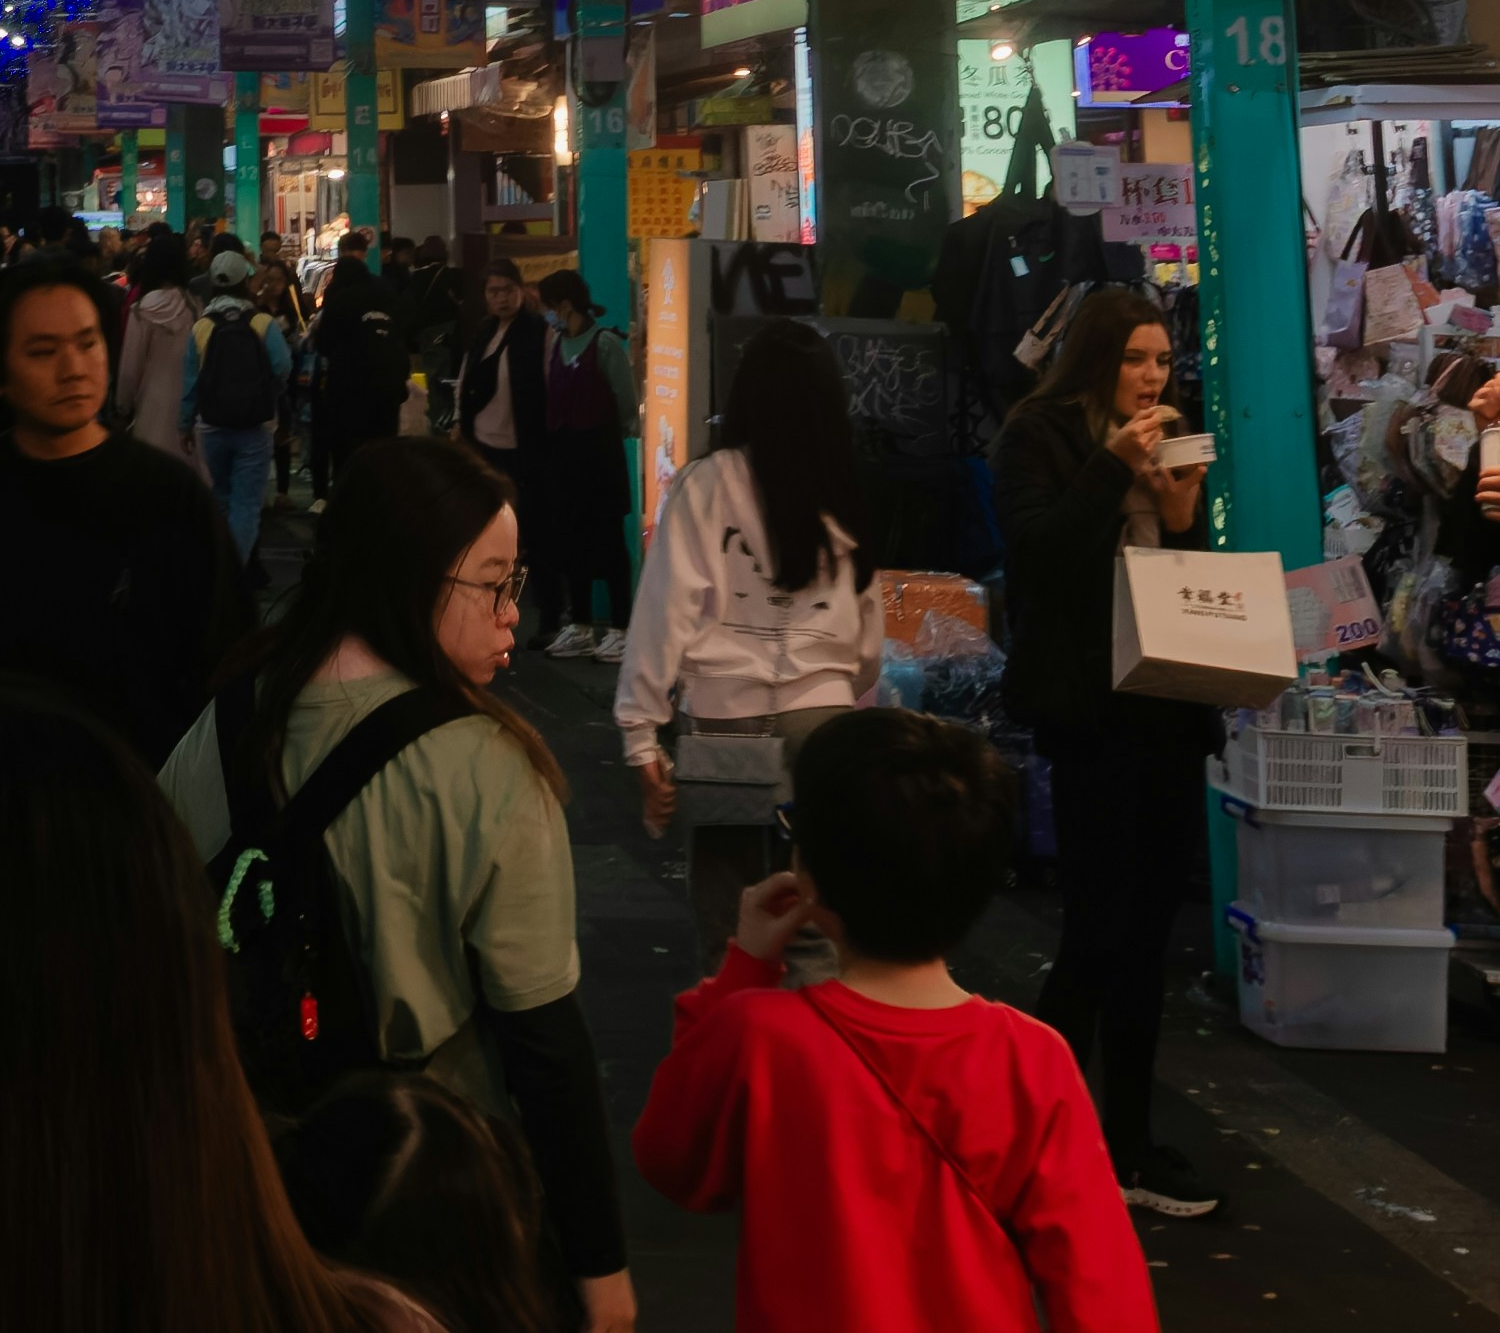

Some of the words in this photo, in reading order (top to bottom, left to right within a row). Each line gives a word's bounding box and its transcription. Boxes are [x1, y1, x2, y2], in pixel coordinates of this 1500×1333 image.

[1224, 15, 1288, 66] 18
[589, 107, 624, 134] 16
[1336, 618, 1380, 644] 200
